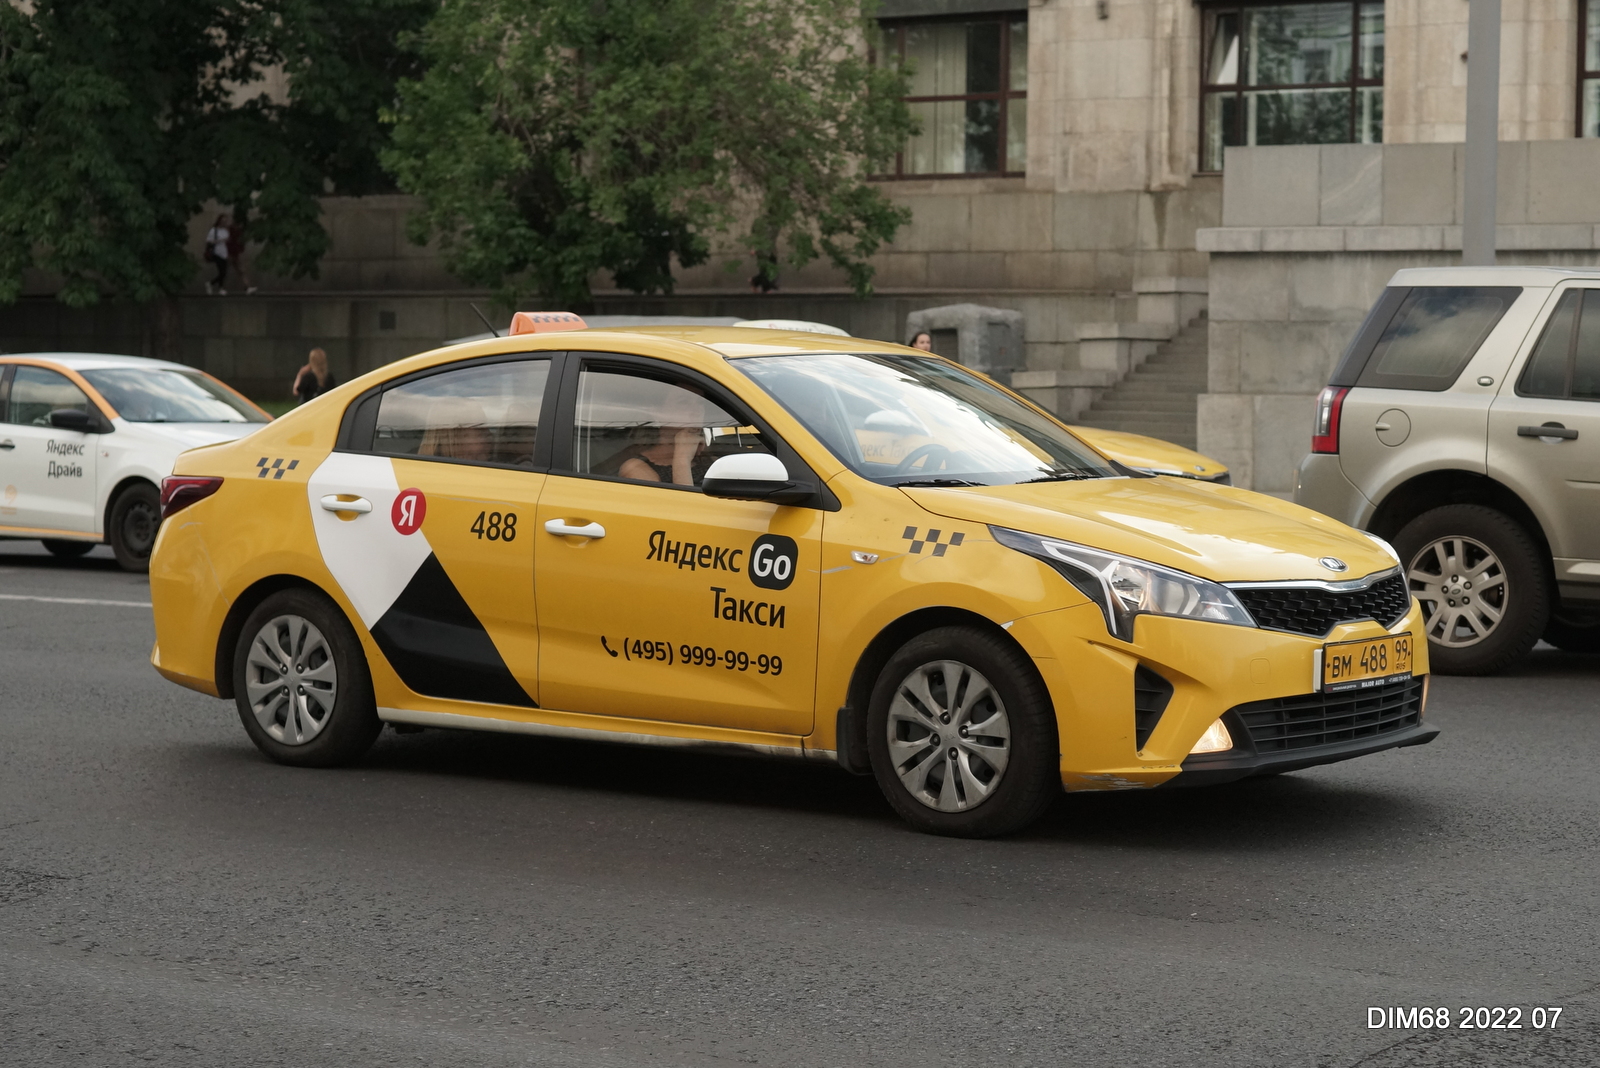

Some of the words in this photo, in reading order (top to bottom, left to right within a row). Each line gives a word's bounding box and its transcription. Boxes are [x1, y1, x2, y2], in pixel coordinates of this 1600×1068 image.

[46, 439, 85, 456] Яндекс
[47, 460, 83, 478] Драйв
[398, 495, 417, 526] Я
[470, 511, 517, 542] 488
[646, 530, 743, 573] Яндекс
[753, 543, 792, 581] Go
[710, 586, 786, 629] Такси
[623, 637, 673, 666] (495)
[679, 644, 783, 676] 999-99-99
[1360, 643, 1387, 674] 488
[1395, 639, 1408, 661] 99
